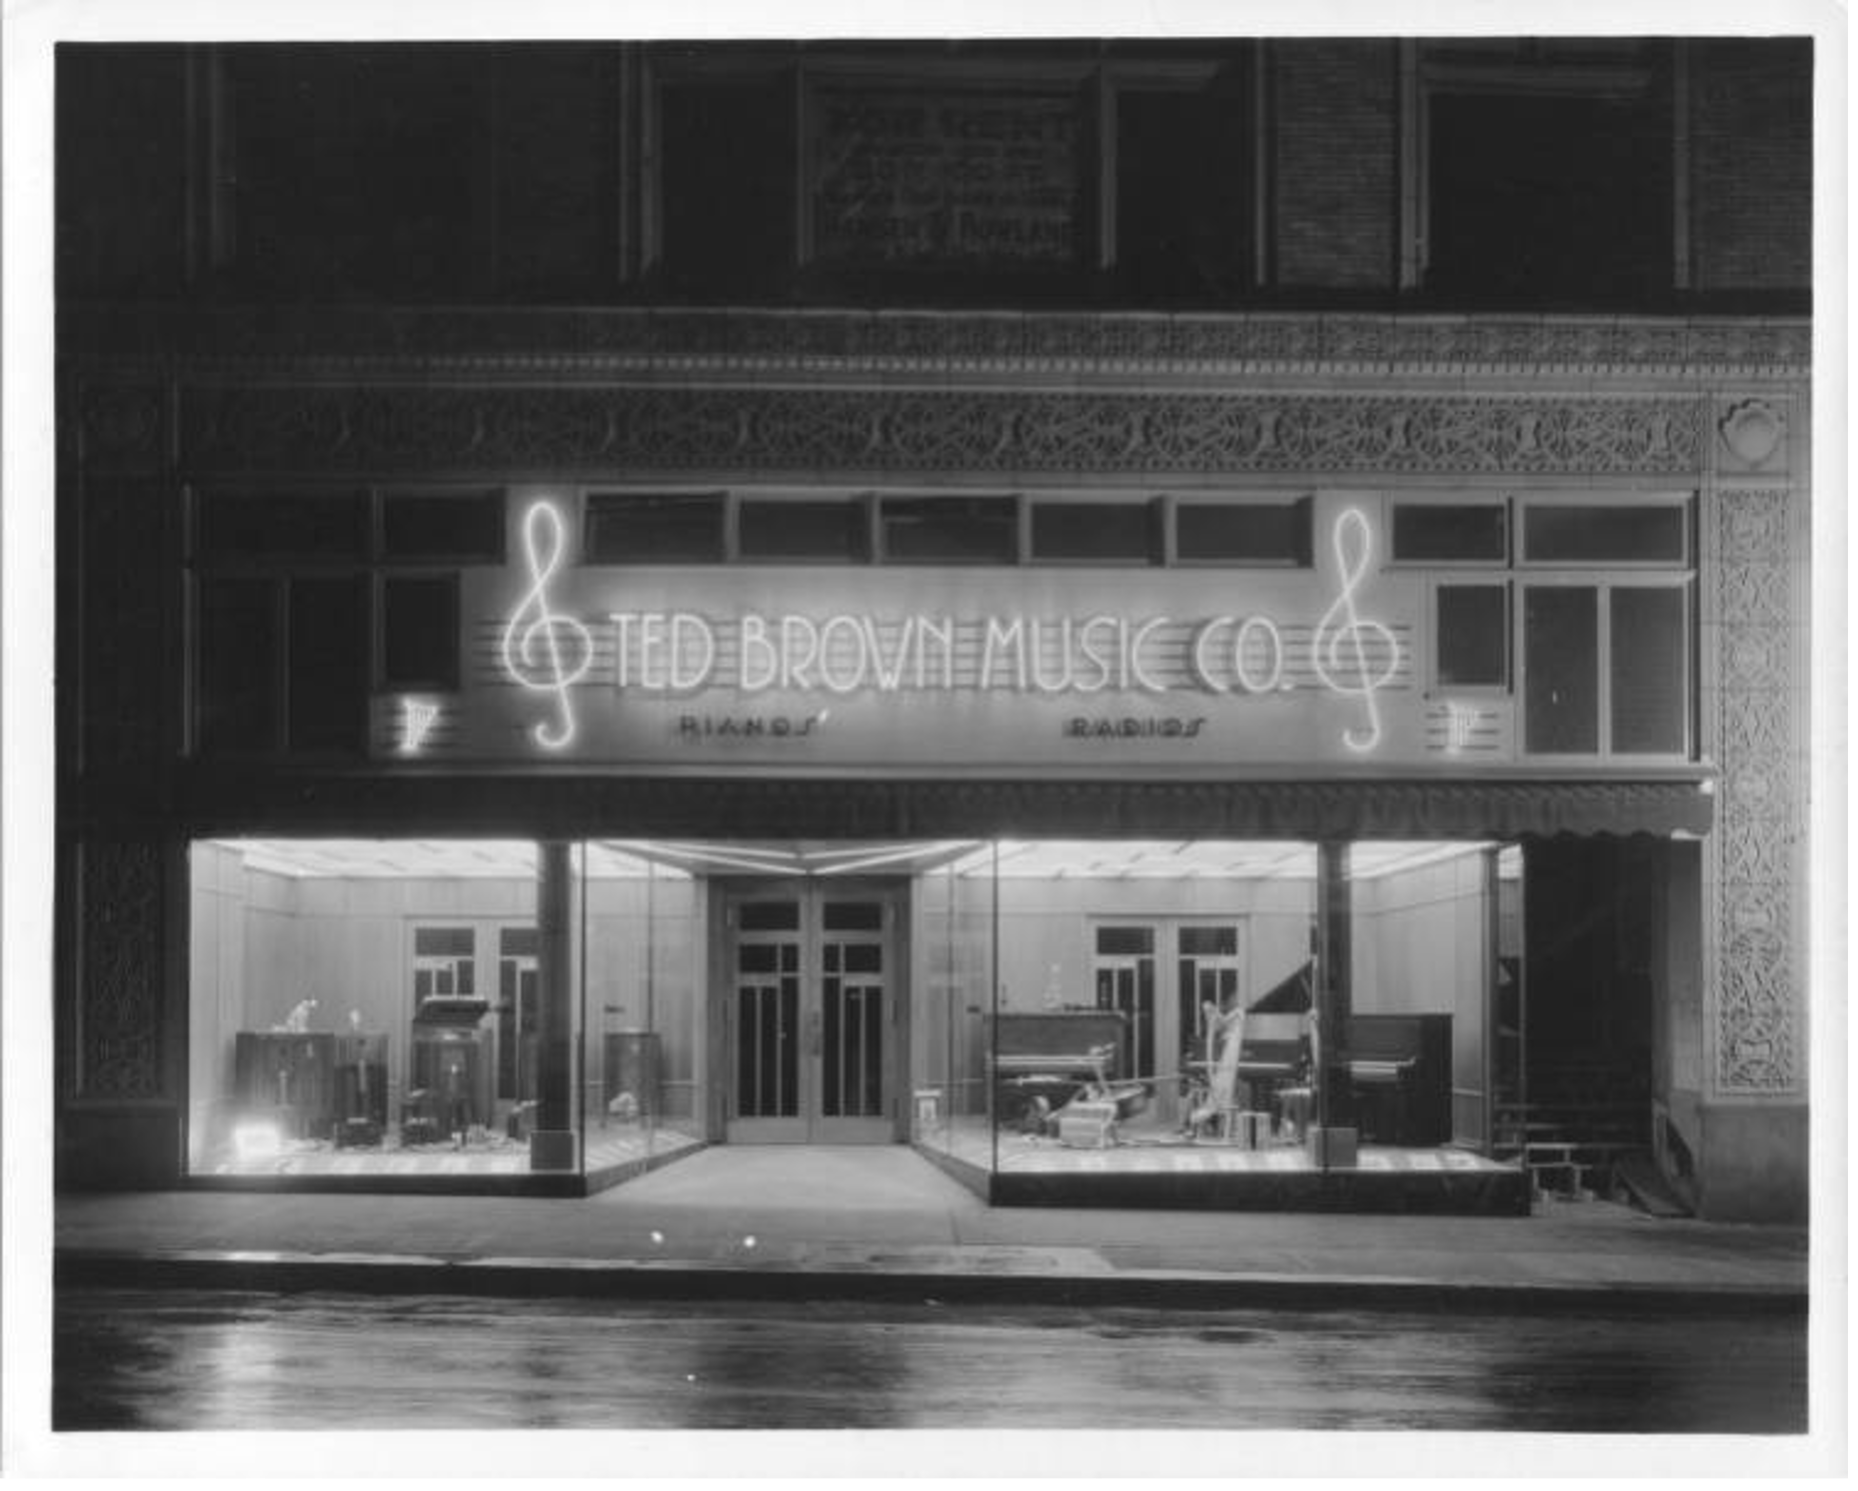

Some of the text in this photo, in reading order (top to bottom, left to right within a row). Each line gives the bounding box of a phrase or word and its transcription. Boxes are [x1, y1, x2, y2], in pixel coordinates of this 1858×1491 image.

[609, 613, 1294, 692] TED BROWN MUSIC CO.
[679, 714, 819, 738] PIANOS
[1064, 716, 1206, 739] RADIOS
